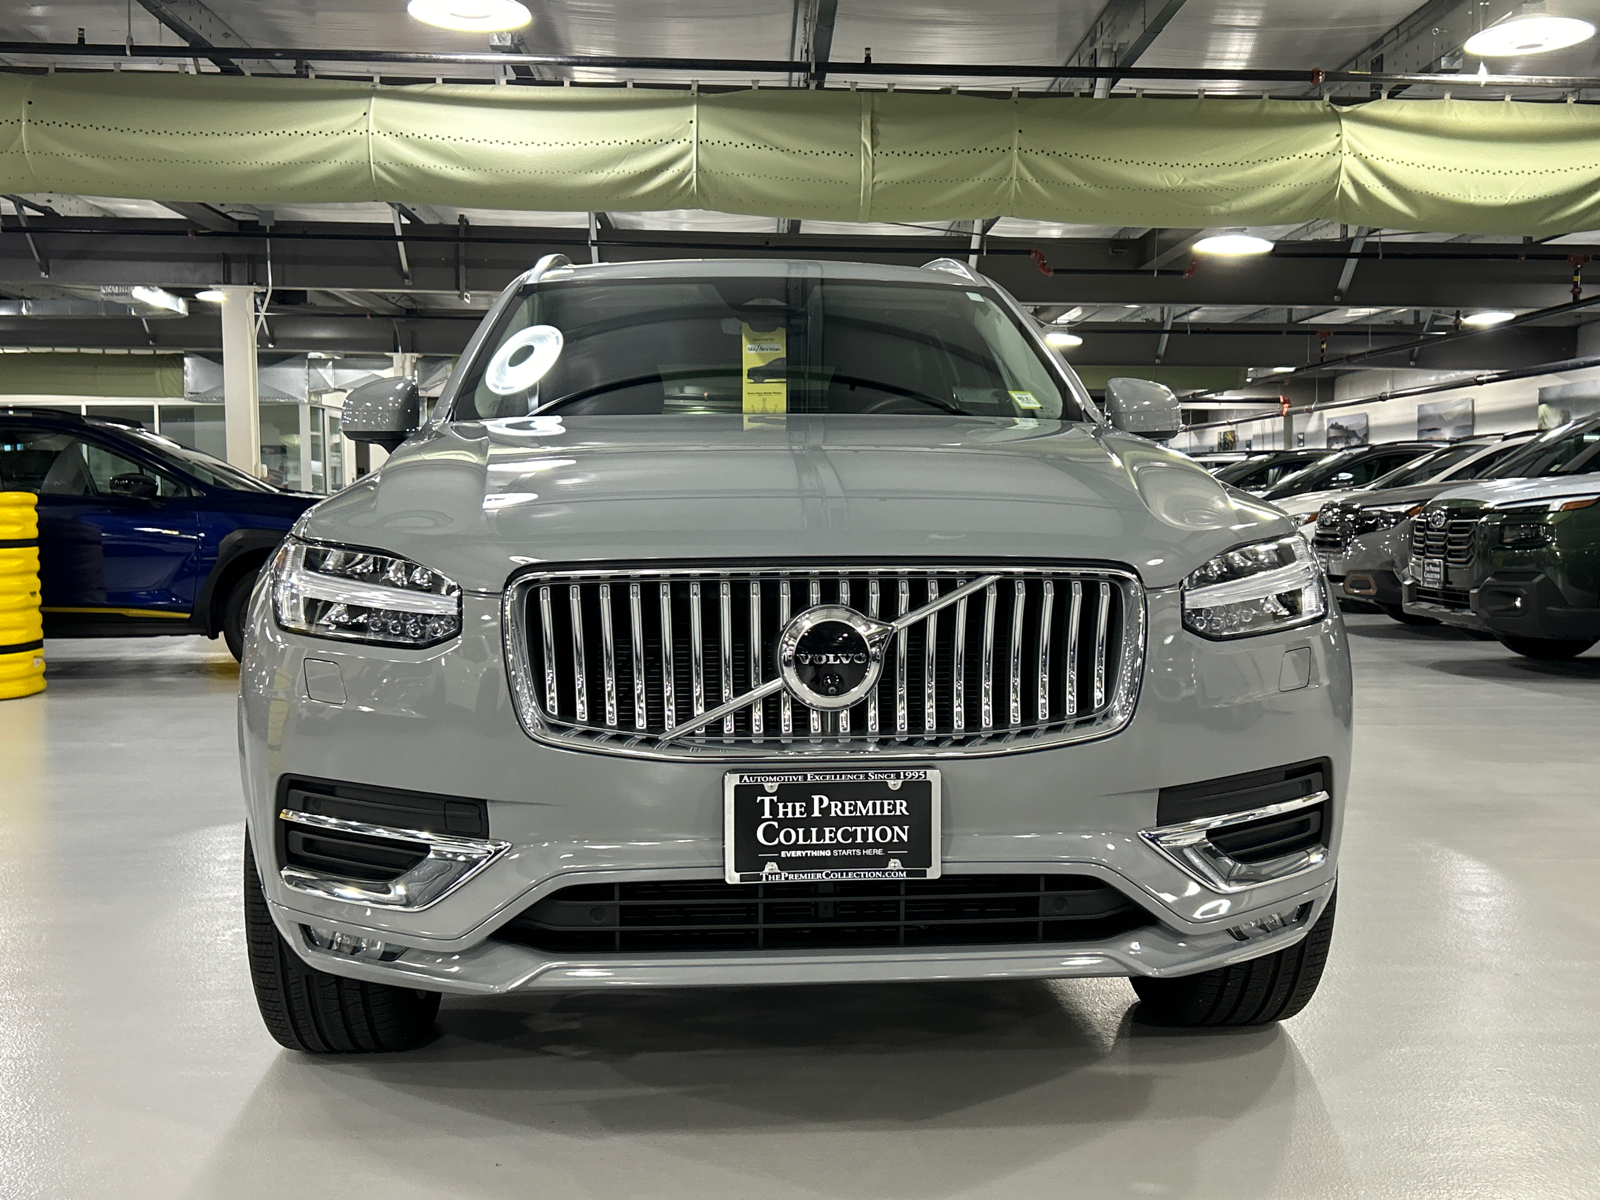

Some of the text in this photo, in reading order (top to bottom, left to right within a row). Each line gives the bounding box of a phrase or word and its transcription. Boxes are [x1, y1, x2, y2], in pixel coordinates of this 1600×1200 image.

[796, 653, 867, 664] VOLVO
[741, 771, 926, 783] AUTOMOTIVE EXCELLENCE SINCE 1995
[756, 795, 909, 819] THE PREMIER
[756, 821, 910, 846] COLLECTION
[780, 850, 831, 858] EVERYTHING
[833, 849, 861, 857] STARTS
